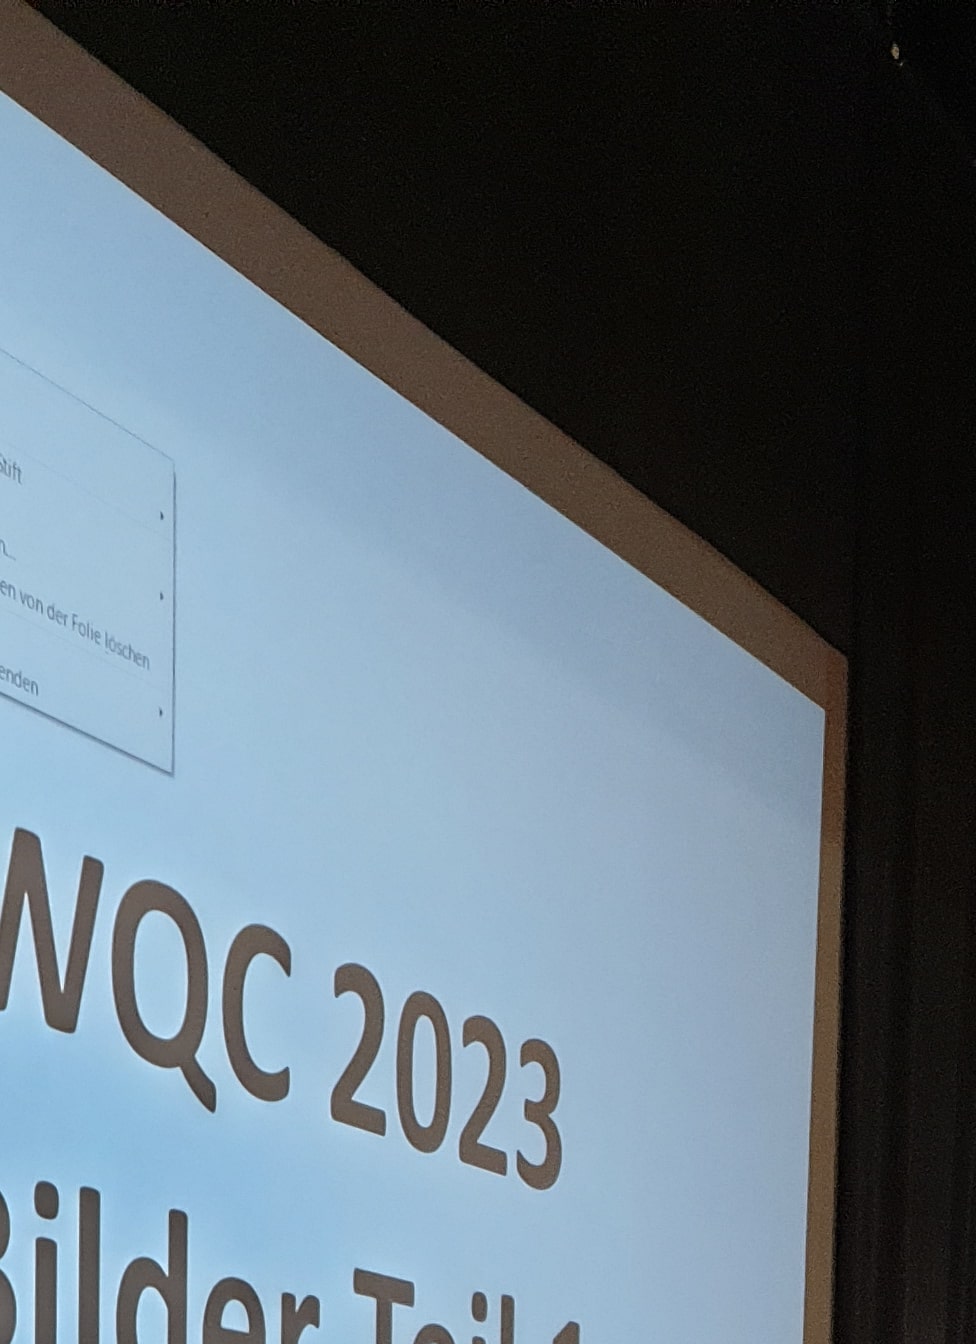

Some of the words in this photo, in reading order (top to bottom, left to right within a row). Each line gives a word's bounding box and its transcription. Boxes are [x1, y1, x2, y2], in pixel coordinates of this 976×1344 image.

[20, 590, 44, 614] von
[47, 604, 68, 627] der
[72, 613, 101, 645] Folie
[0, 827, 292, 1114] WQC
[330, 962, 562, 1190] 2023
